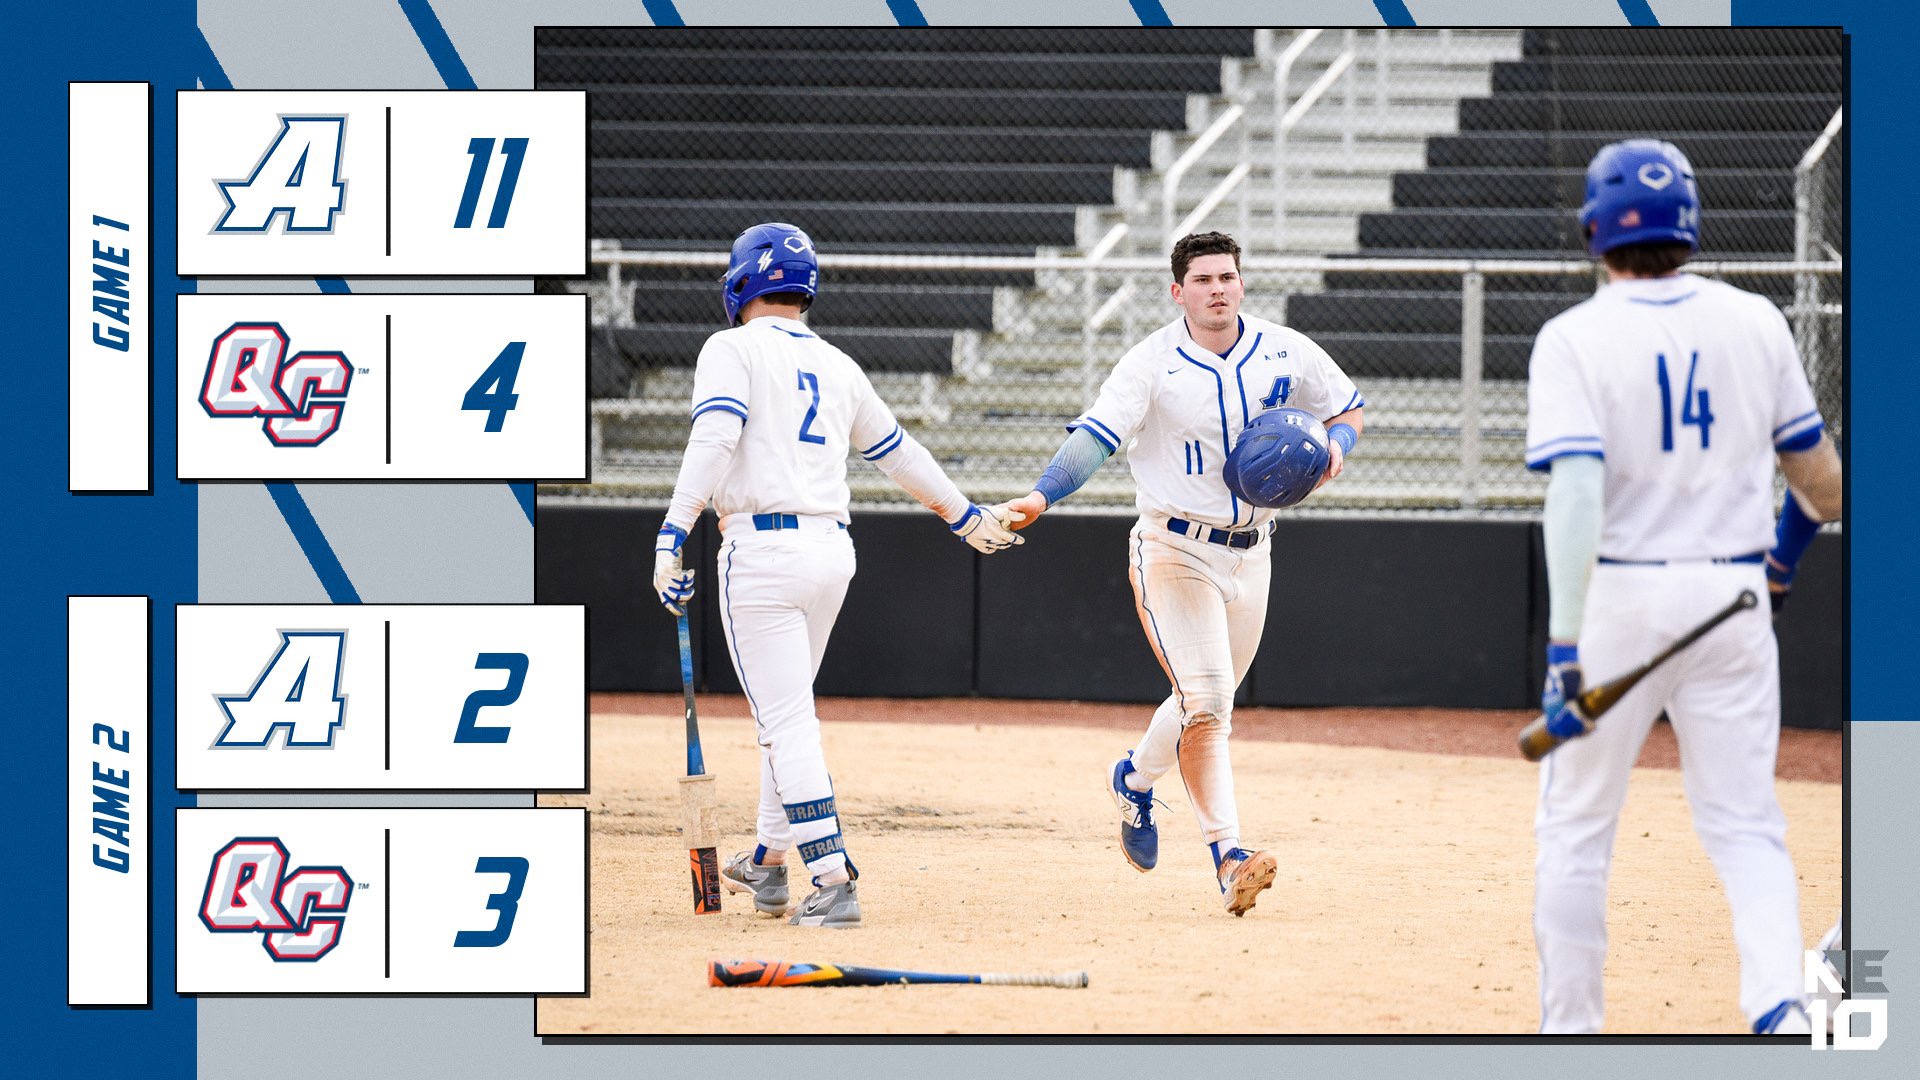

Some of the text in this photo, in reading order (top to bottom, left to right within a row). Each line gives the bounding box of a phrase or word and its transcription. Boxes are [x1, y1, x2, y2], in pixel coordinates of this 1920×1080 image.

[798, 369, 825, 445] 2
[1259, 374, 1294, 410] A
[1657, 351, 1714, 452] 14
[1185, 440, 1203, 475] 11
